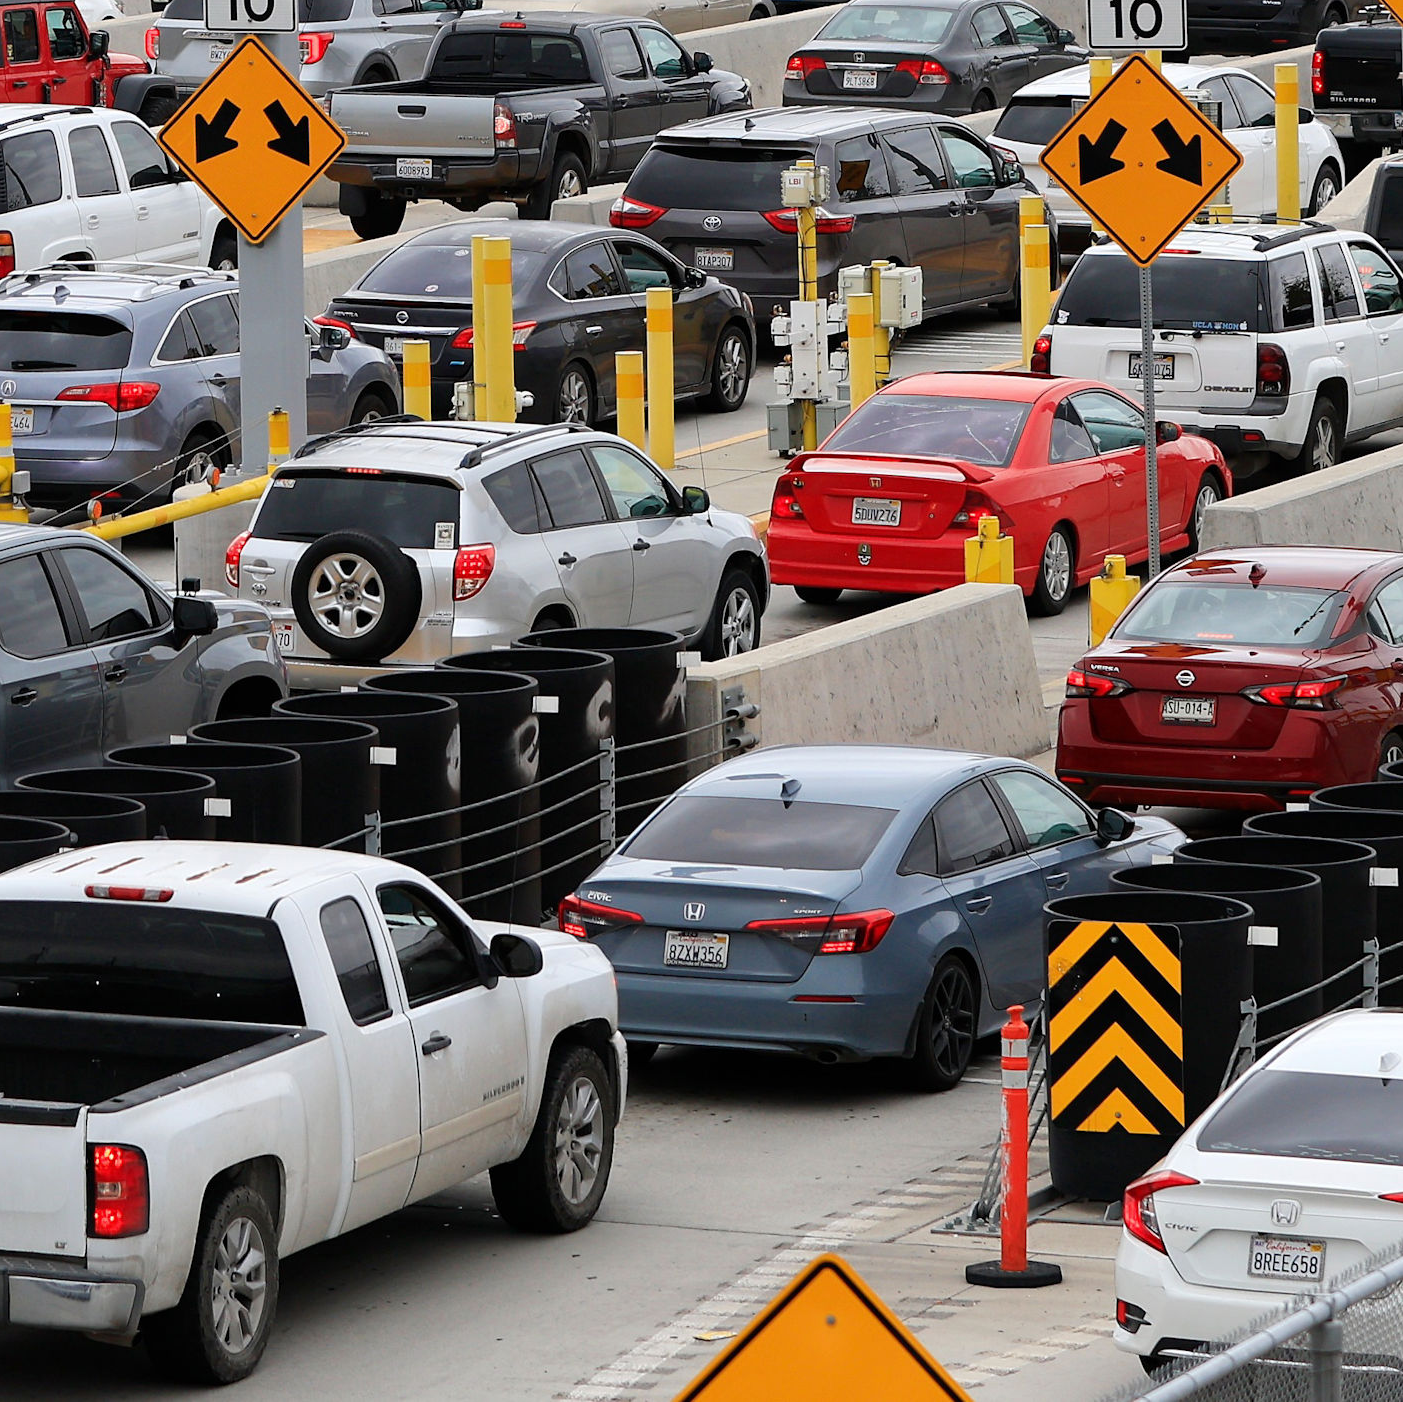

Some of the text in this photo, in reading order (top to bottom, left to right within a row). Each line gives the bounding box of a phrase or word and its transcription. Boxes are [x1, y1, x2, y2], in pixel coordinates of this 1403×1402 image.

[1330, 96, 1377, 104] SILVERADO
[514, 112, 533, 123] TRD
[788, 178, 801, 186] LBI
[1192, 320, 1213, 329] UCLA
[1204, 384, 1254, 394] CHEVROLET
[855, 506, 897, 522] 5DUV276
[1090, 663, 1120, 673] VERSA
[587, 891, 612, 902] CIVIC
[669, 944, 723, 962] 8ZXW356
[1165, 1222, 1199, 1233] CIVIC
[1265, 1239, 1311, 1253] California
[1254, 1251, 1318, 1275] 8REE658
